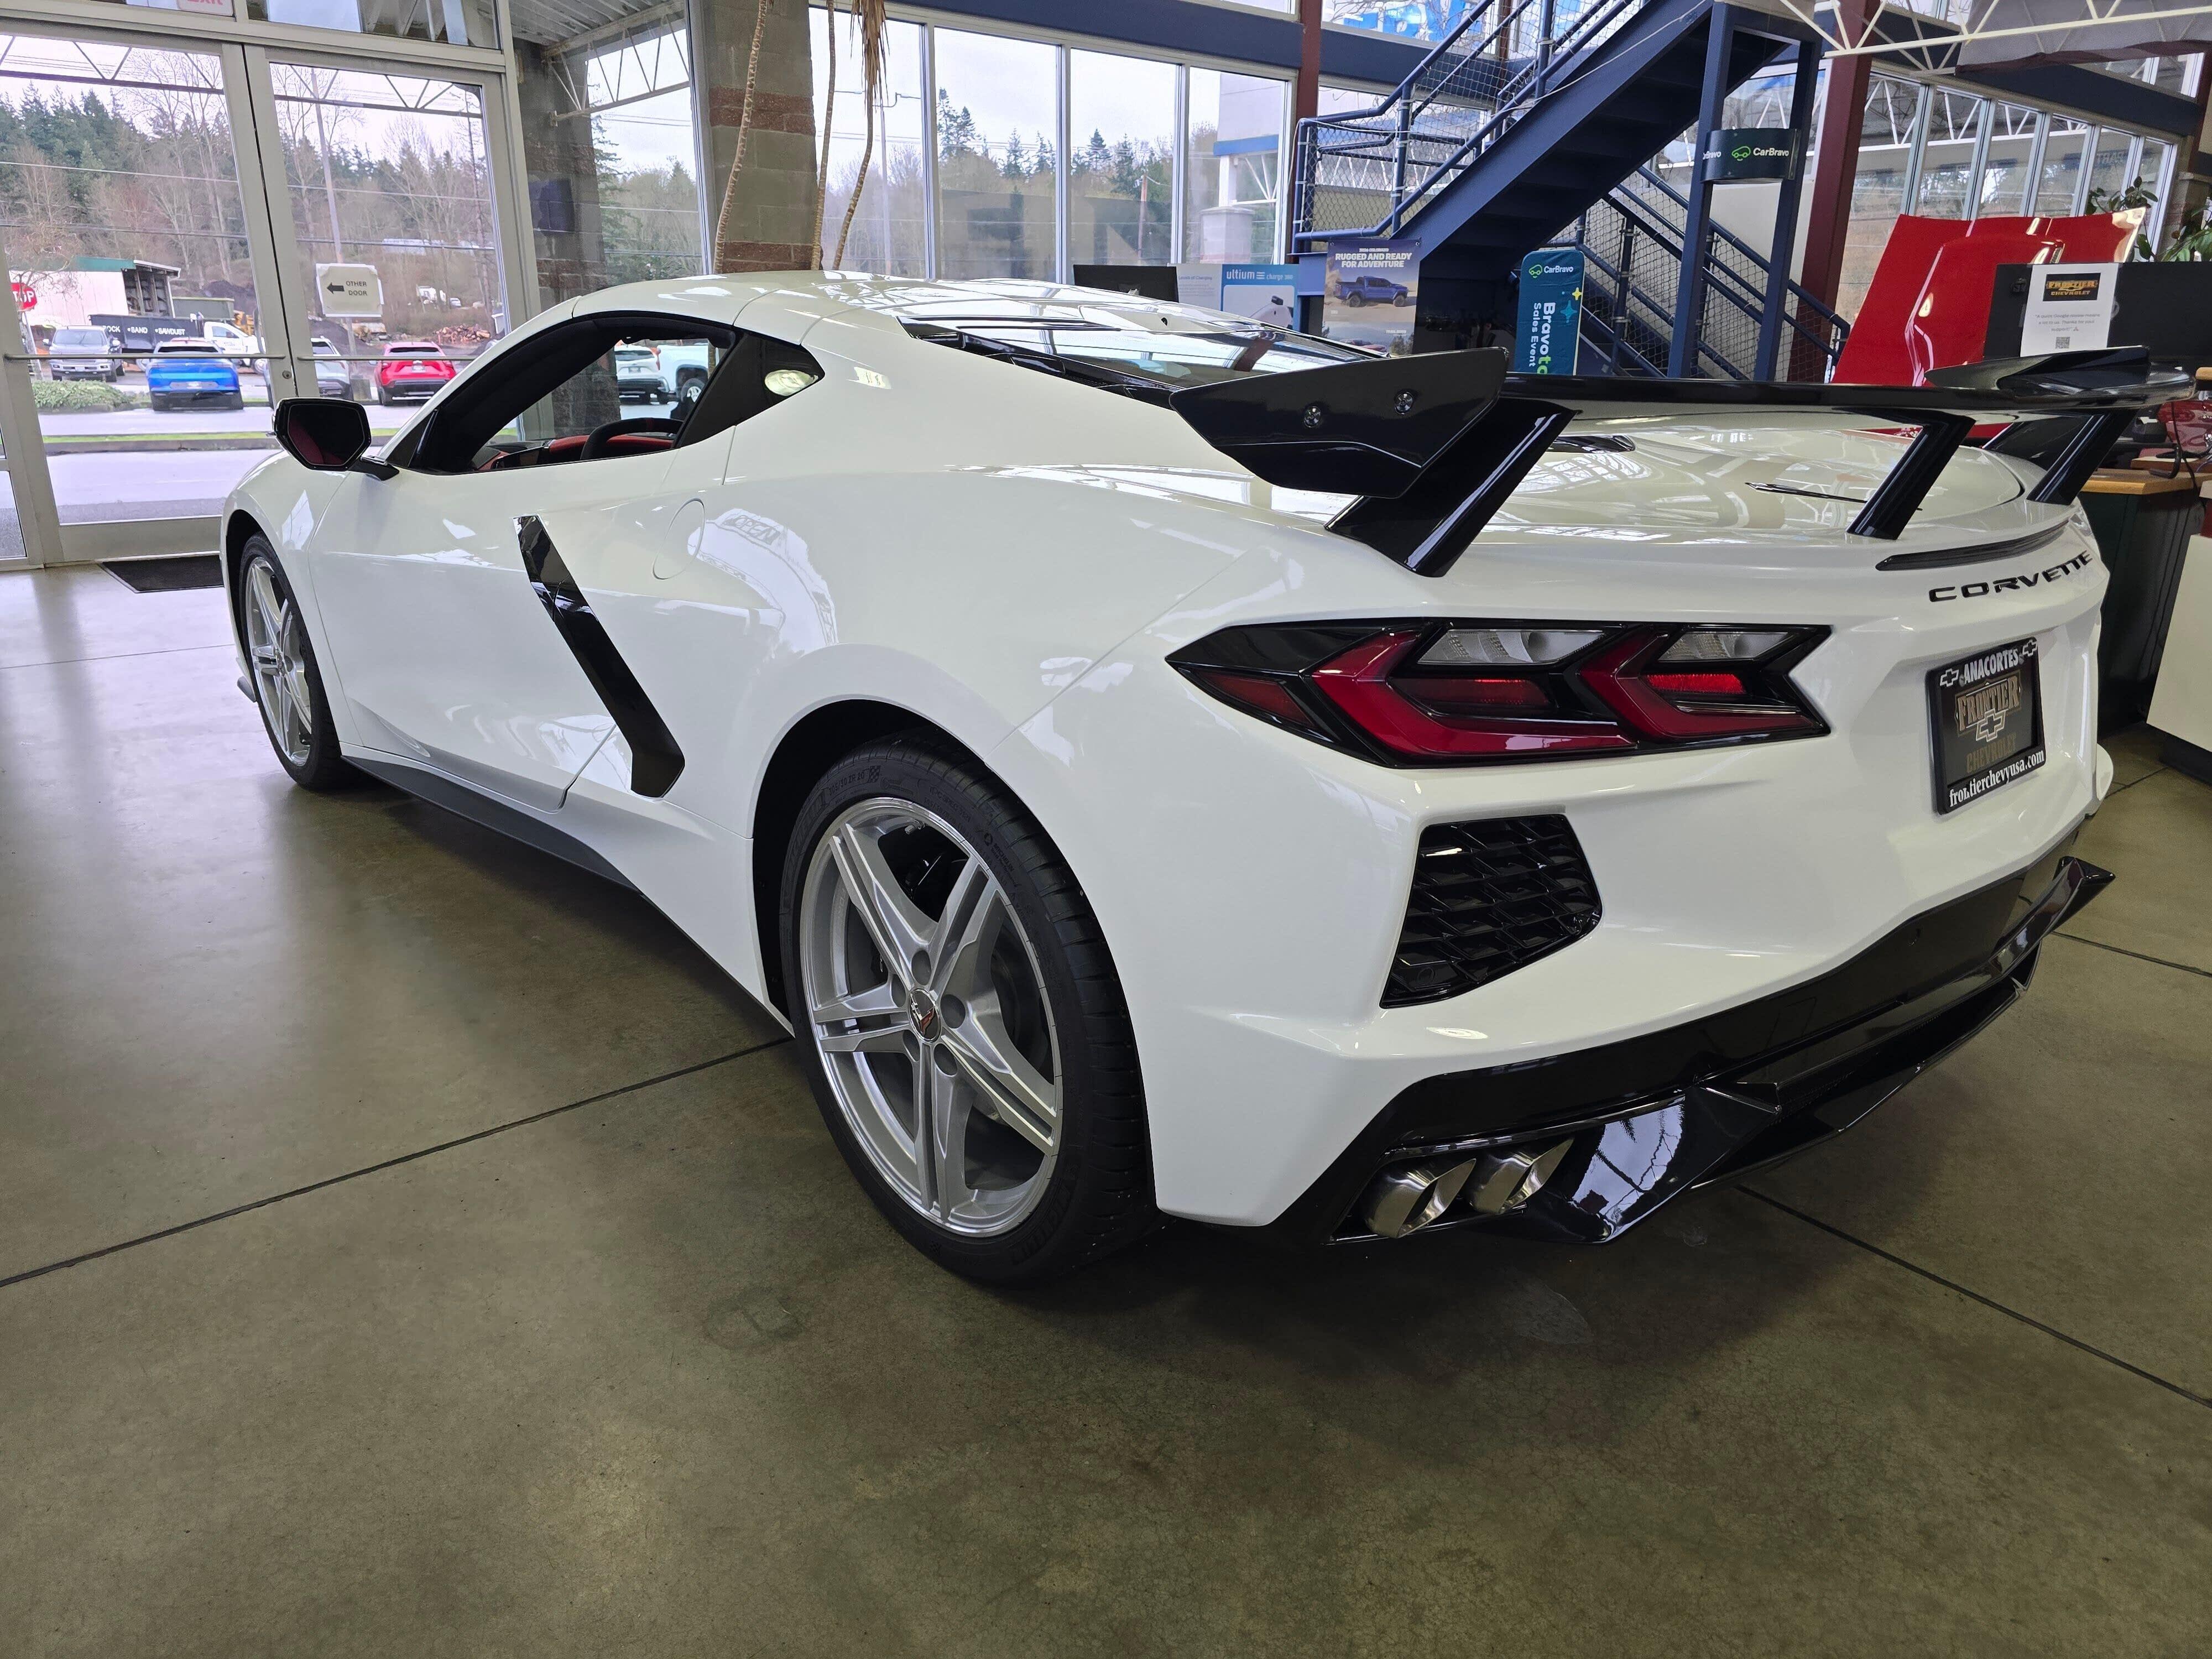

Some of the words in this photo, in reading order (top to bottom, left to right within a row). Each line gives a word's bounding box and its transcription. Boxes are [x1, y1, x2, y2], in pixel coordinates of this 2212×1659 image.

[1752, 147, 1790, 157] CarBravo
[1226, 269, 1255, 279] ultium
[1543, 265, 1574, 274] CarBravo
[1532, 302, 1542, 333] Sales
[1528, 335, 1539, 367] Event
[1929, 550, 2093, 602] CORVETTE
[1964, 649, 2018, 685] ANACORTES
[1957, 675, 2020, 731] FRONTIER
[1965, 733, 2016, 774] CHEVROLET
[993, 843, 1014, 872] MICHELIN
